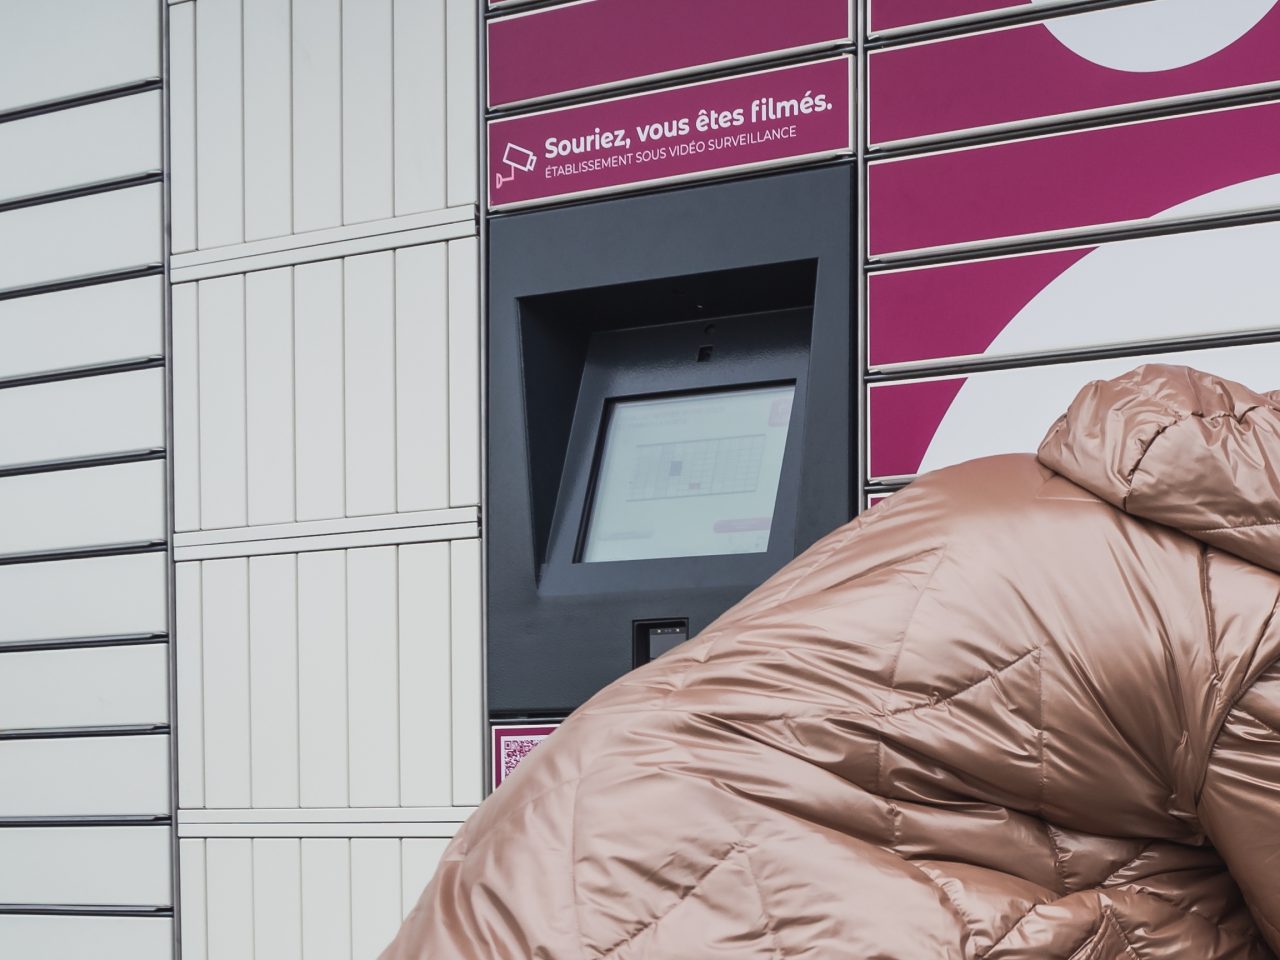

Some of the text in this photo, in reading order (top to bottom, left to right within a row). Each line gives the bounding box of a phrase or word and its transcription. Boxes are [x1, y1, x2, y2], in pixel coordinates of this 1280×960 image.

[545, 91, 833, 158] Souriez, vous êtes filmés.
[545, 125, 797, 179] ÉTABLISSEMENT SOUS VIDÉO SURVEILLANCE
